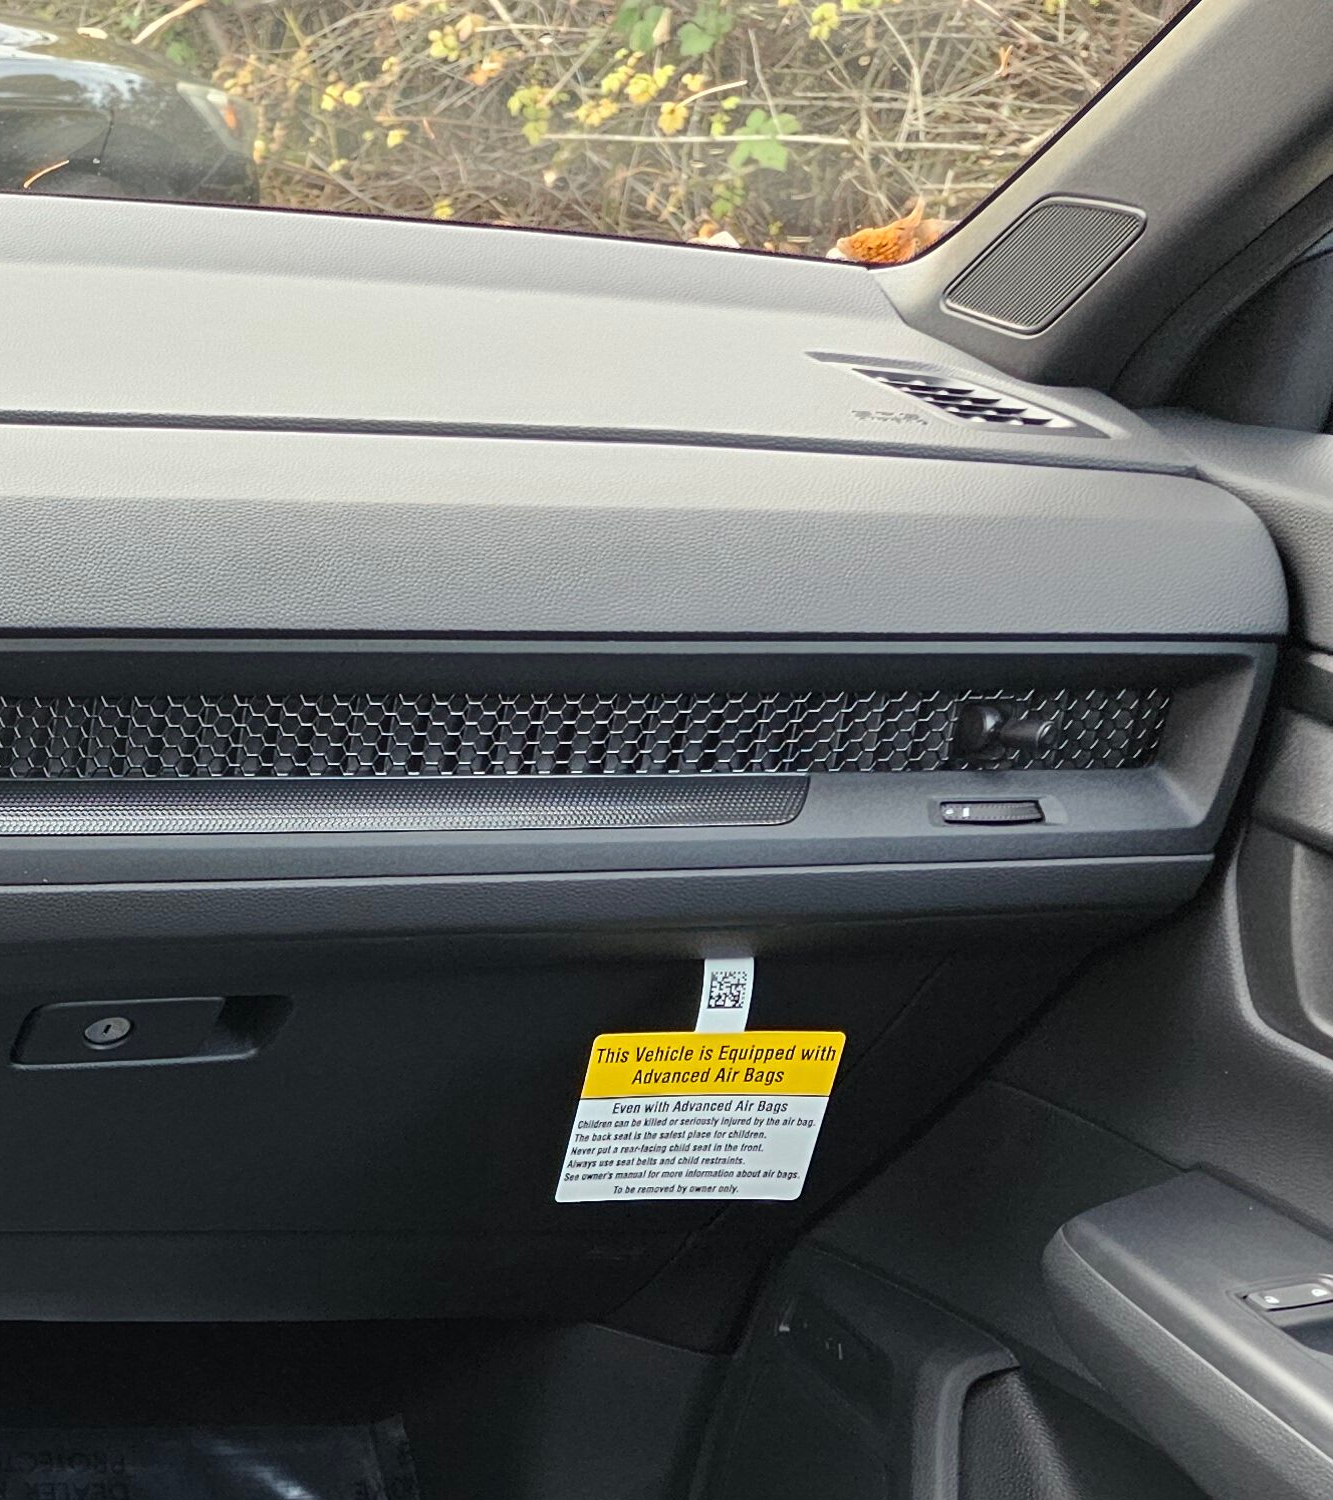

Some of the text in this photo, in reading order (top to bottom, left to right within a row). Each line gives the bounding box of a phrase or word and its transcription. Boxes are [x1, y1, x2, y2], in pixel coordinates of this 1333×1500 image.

[597, 1044, 836, 1064] This Vehicle is Equipped with
[631, 1067, 785, 1086] Advanced Air Bags
[612, 1099, 789, 1115] Even with Advanced Air Bags
[577, 1116, 816, 1130] Children can be killed seriously injured by the air bag.
[575, 1130, 767, 1143] The back seat the safest place for children.
[571, 1142, 764, 1156] Never put rear-facing child seat the front.
[567, 1159, 596, 1169] Always
[615, 1158, 635, 1166] seat
[636, 1157, 658, 1166] belts
[659, 1157, 675, 1165] and
[677, 1156, 699, 1165] child
[700, 1156, 746, 1165] restraints.
[564, 1172, 579, 1181] See
[581, 1171, 613, 1181] owner's
[615, 1170, 646, 1179] manual
[647, 1169, 660, 1179] for
[685, 1169, 735, 1178] information
[736, 1169, 761, 1178] about
[762, 1169, 776, 1178] air
[776, 1170, 801, 1180] bags.
[613, 1184, 739, 1195] To be removed by owner only.
